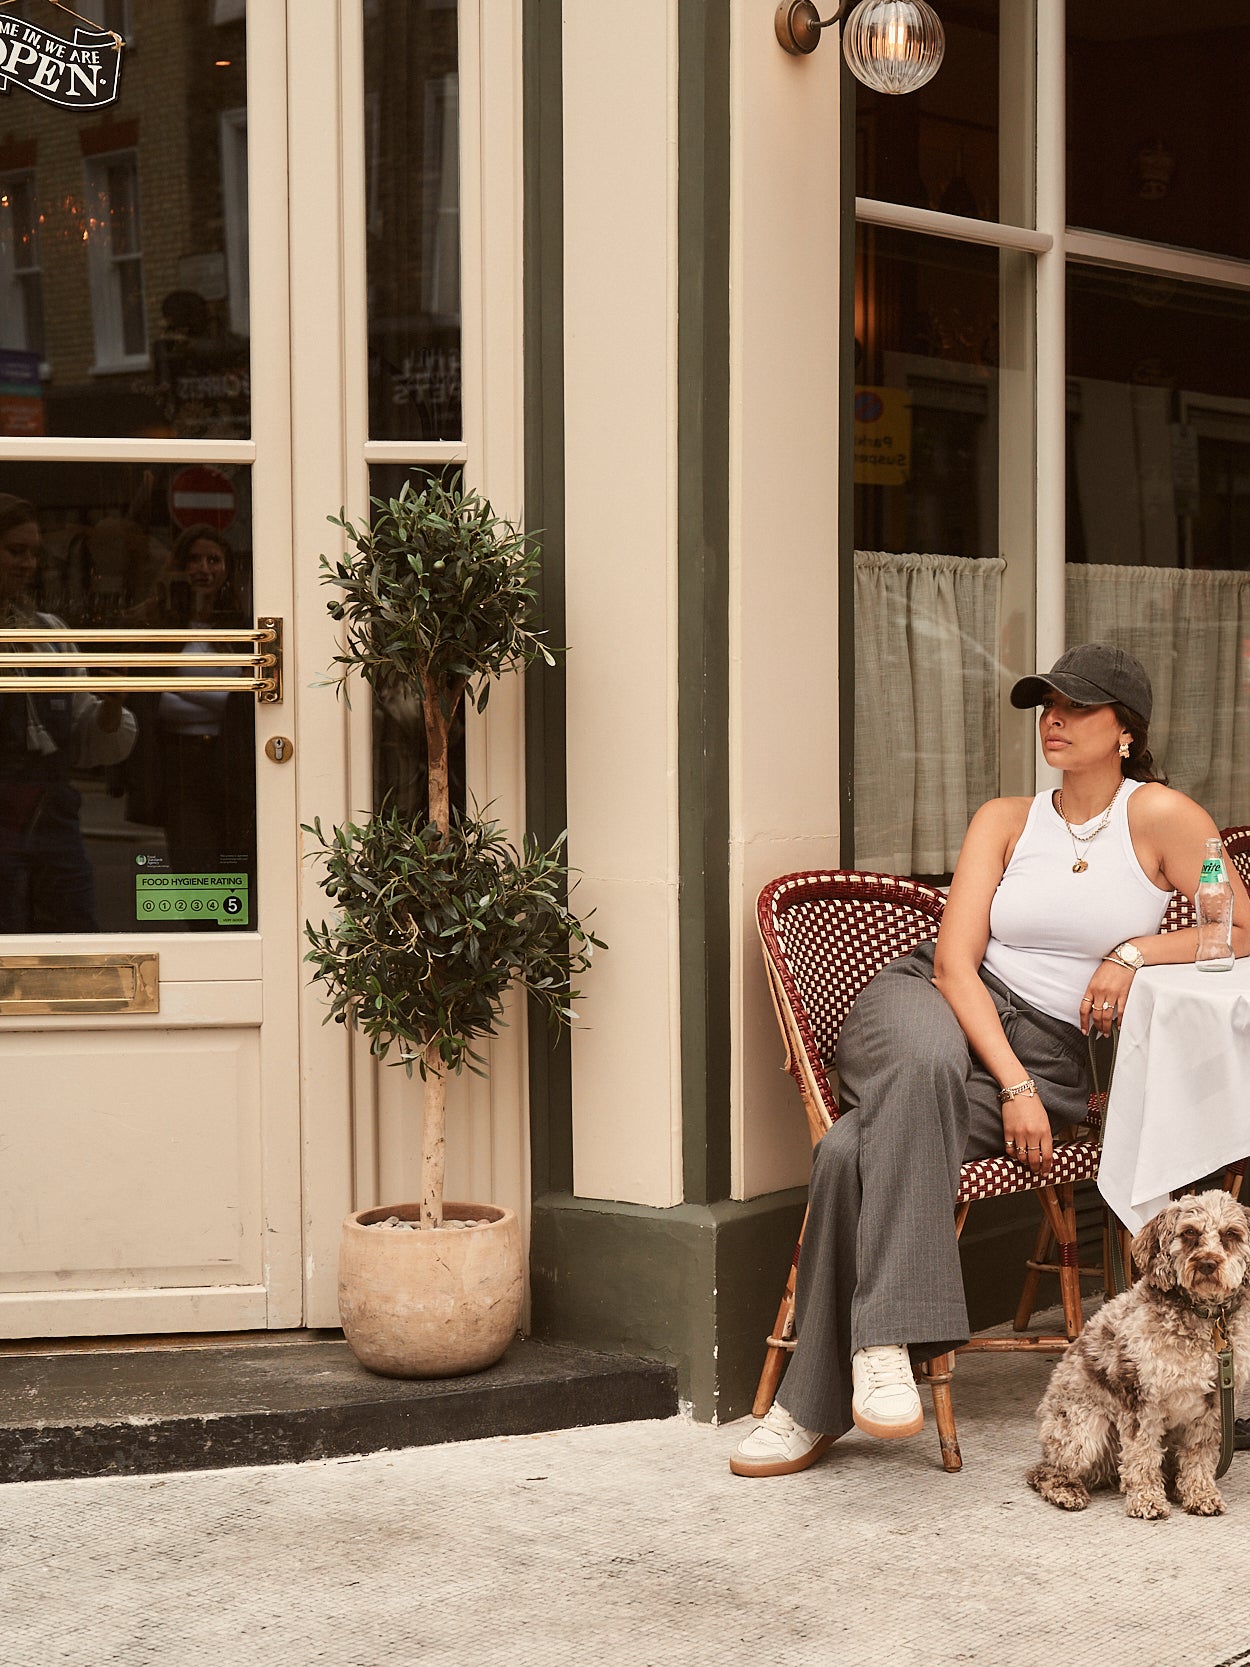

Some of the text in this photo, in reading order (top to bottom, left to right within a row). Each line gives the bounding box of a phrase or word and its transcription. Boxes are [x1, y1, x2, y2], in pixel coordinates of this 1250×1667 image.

[22, 28, 42, 50] IN,
[45, 40, 67, 58] WE
[69, 49, 100, 64] ARE
[142, 877, 242, 886] FOOD HYGIENE RATING
